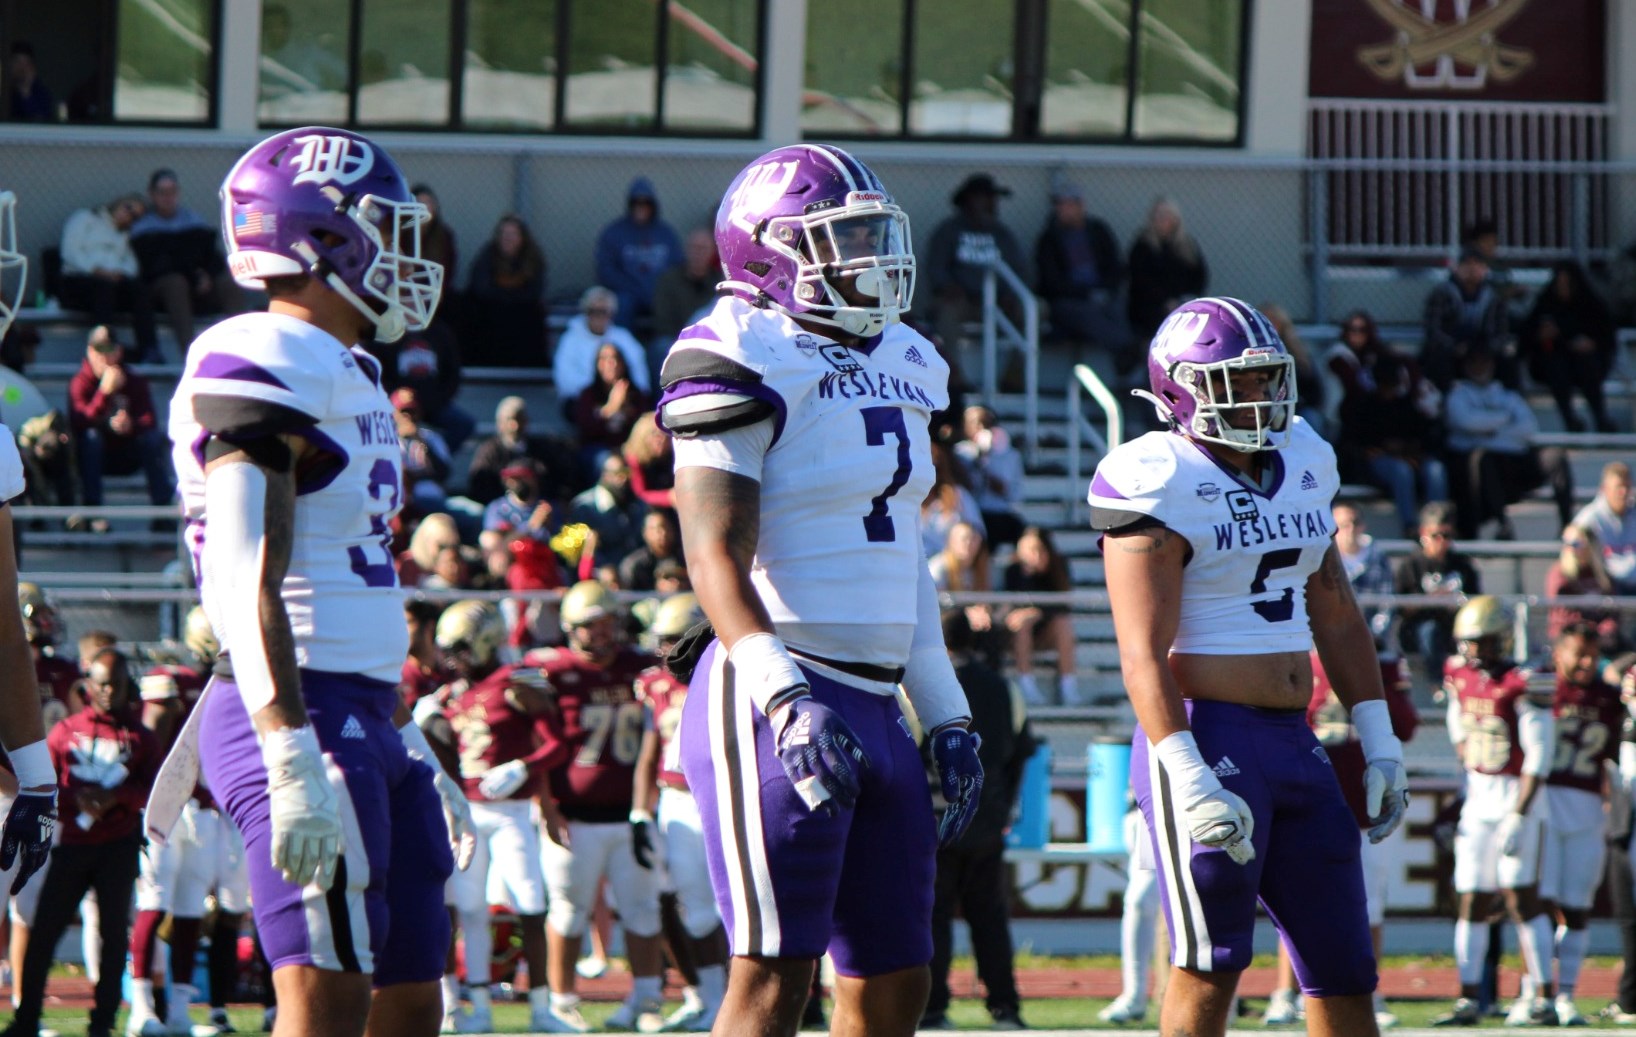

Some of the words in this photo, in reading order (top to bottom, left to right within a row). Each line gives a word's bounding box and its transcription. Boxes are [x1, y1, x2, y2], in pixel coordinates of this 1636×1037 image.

[346, 458, 400, 588] 3
[858, 405, 913, 543] 7
[1249, 547, 1303, 623] 5
[575, 703, 643, 764] 76
